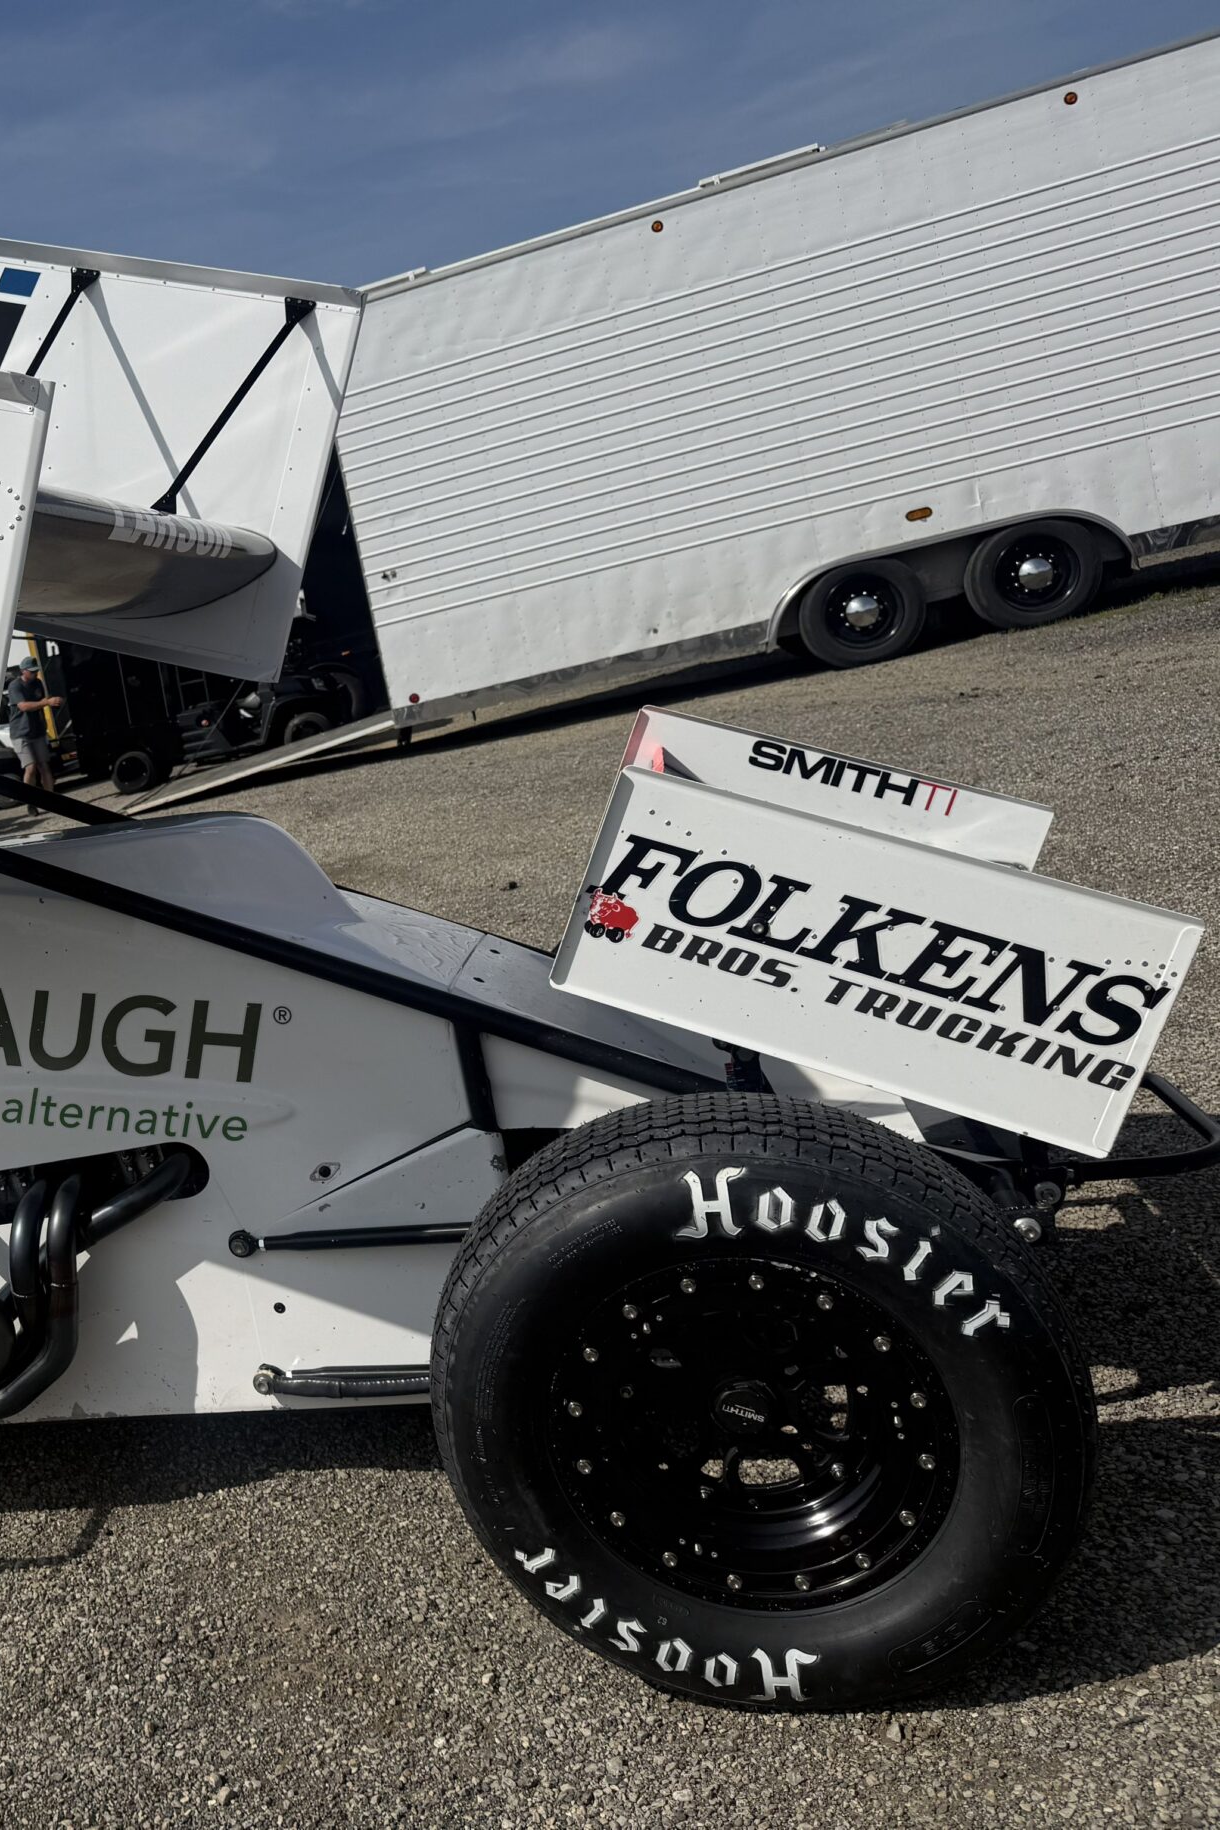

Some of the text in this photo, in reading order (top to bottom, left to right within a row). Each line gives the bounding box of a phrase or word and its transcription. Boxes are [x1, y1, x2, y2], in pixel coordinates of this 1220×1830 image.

[585, 834, 1172, 1047] FOLKENS
[641, 922, 1139, 1093] BROS. TRUCKING
[1, 1086, 249, 1143] alternative
[675, 1165, 1011, 1337] Hoosier
[514, 1545, 822, 1701] Hoosier
